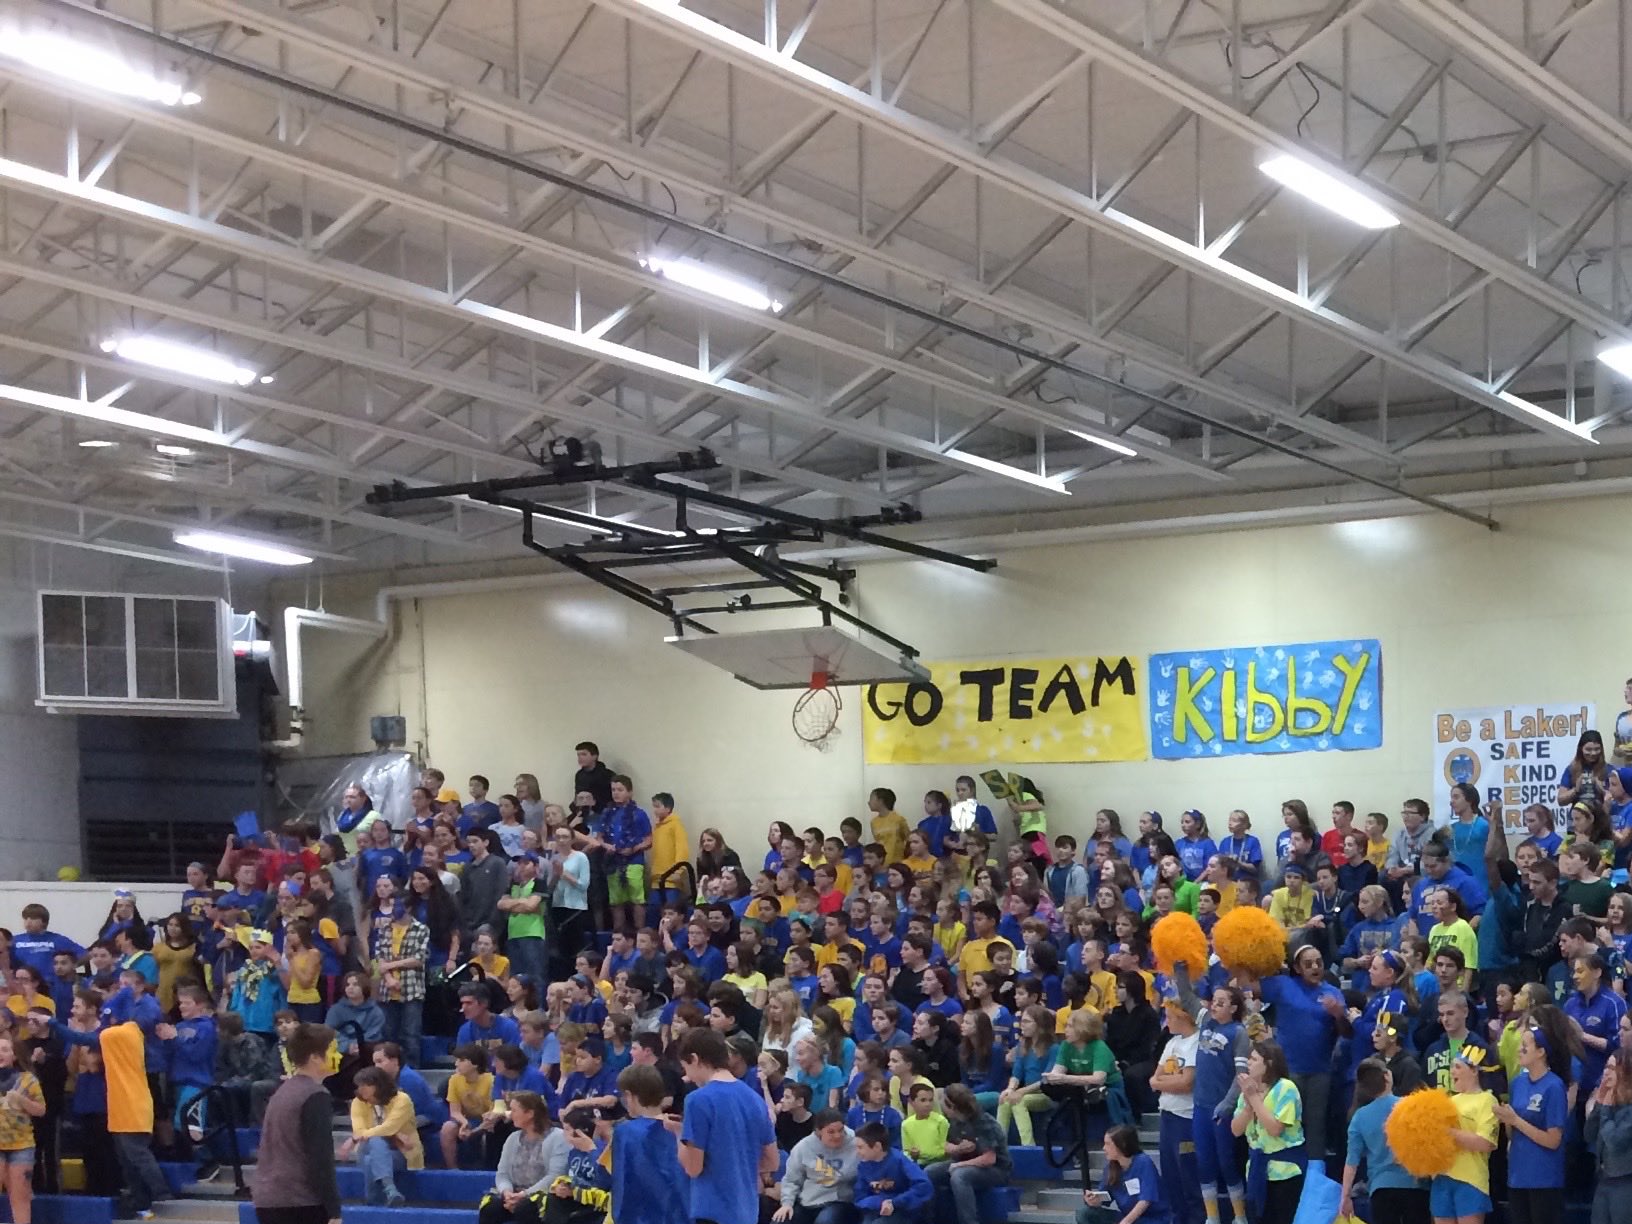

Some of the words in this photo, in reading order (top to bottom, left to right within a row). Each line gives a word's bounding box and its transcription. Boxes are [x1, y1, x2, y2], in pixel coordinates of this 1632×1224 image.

[867, 681, 943, 727] GO
[960, 656, 1136, 722] TEAM
[1437, 713, 1472, 743] Be
[1480, 718, 1496, 742] a
[1504, 706, 1588, 740] Laker!
[1490, 740, 1551, 761] SAFE
[1504, 763, 1557, 784] KIND
[1488, 785, 1563, 806] RESPEC
